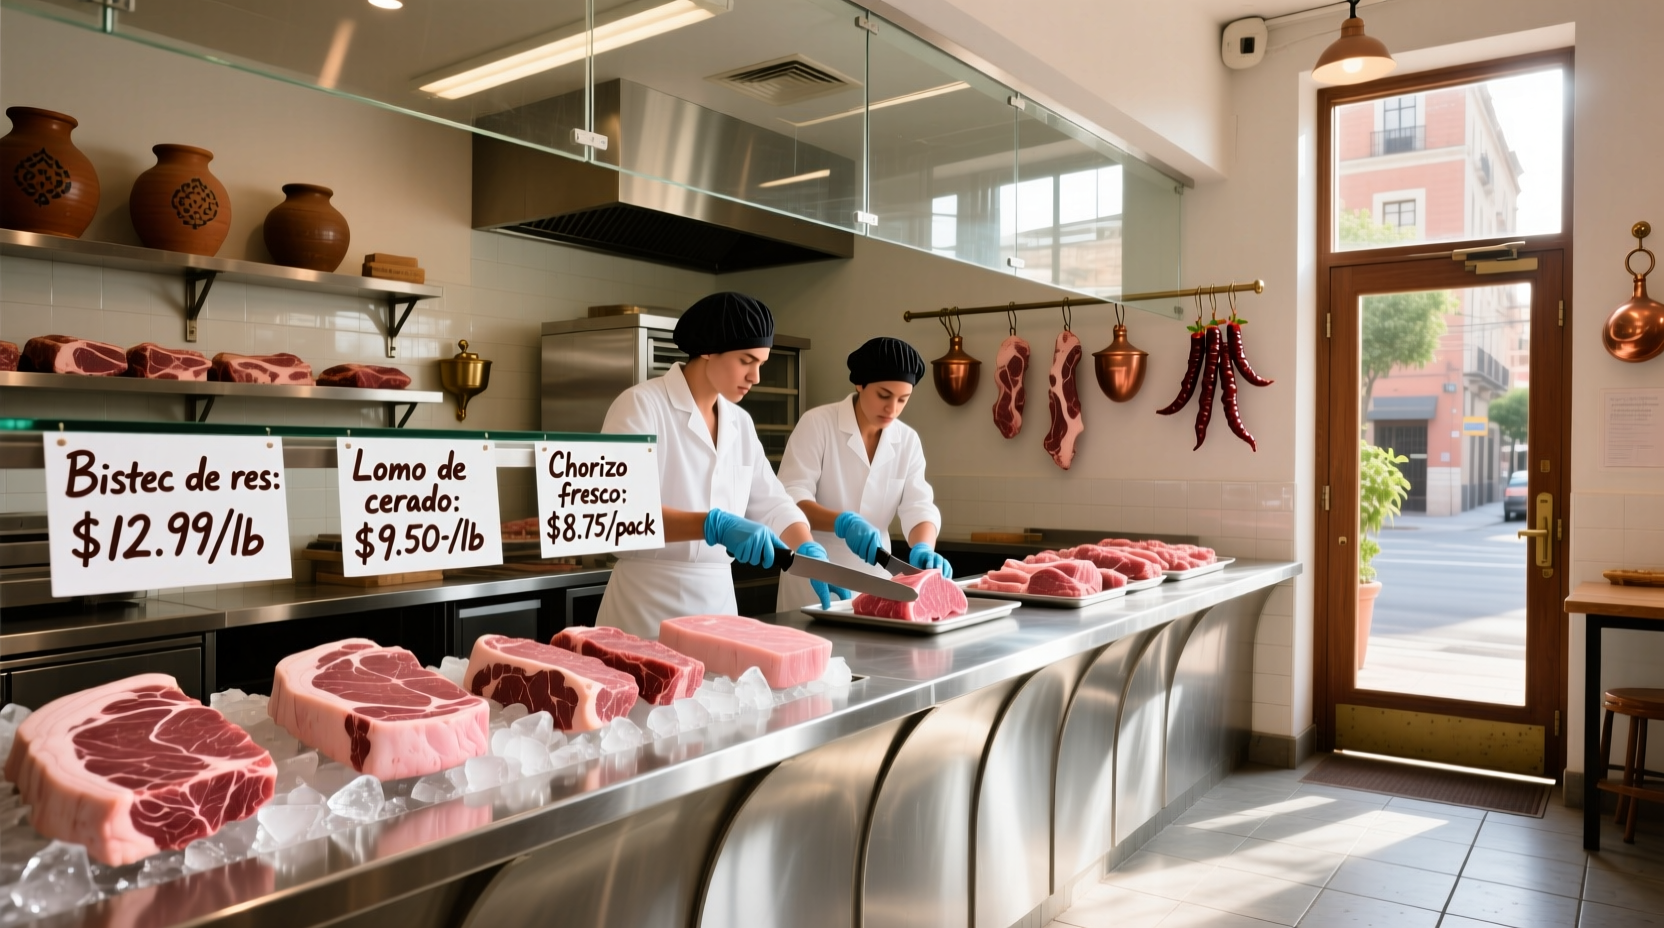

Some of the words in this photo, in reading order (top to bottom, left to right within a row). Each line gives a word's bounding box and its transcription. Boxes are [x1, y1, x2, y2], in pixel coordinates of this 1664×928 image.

[65, 449, 175, 499] Bistec
[185, 455, 221, 492] de
[230, 469, 281, 491] res:
[352, 449, 427, 482] Lomo
[437, 449, 467, 481] de
[548, 451, 628, 479] Chorizo
[364, 482, 460, 515] cerado:
[557, 481, 627, 509] fresco:
[71, 507, 265, 568] $12.99/lb
[354, 517, 485, 566] $9.50-/lb
[546, 509, 656, 546] $8.75/pack
